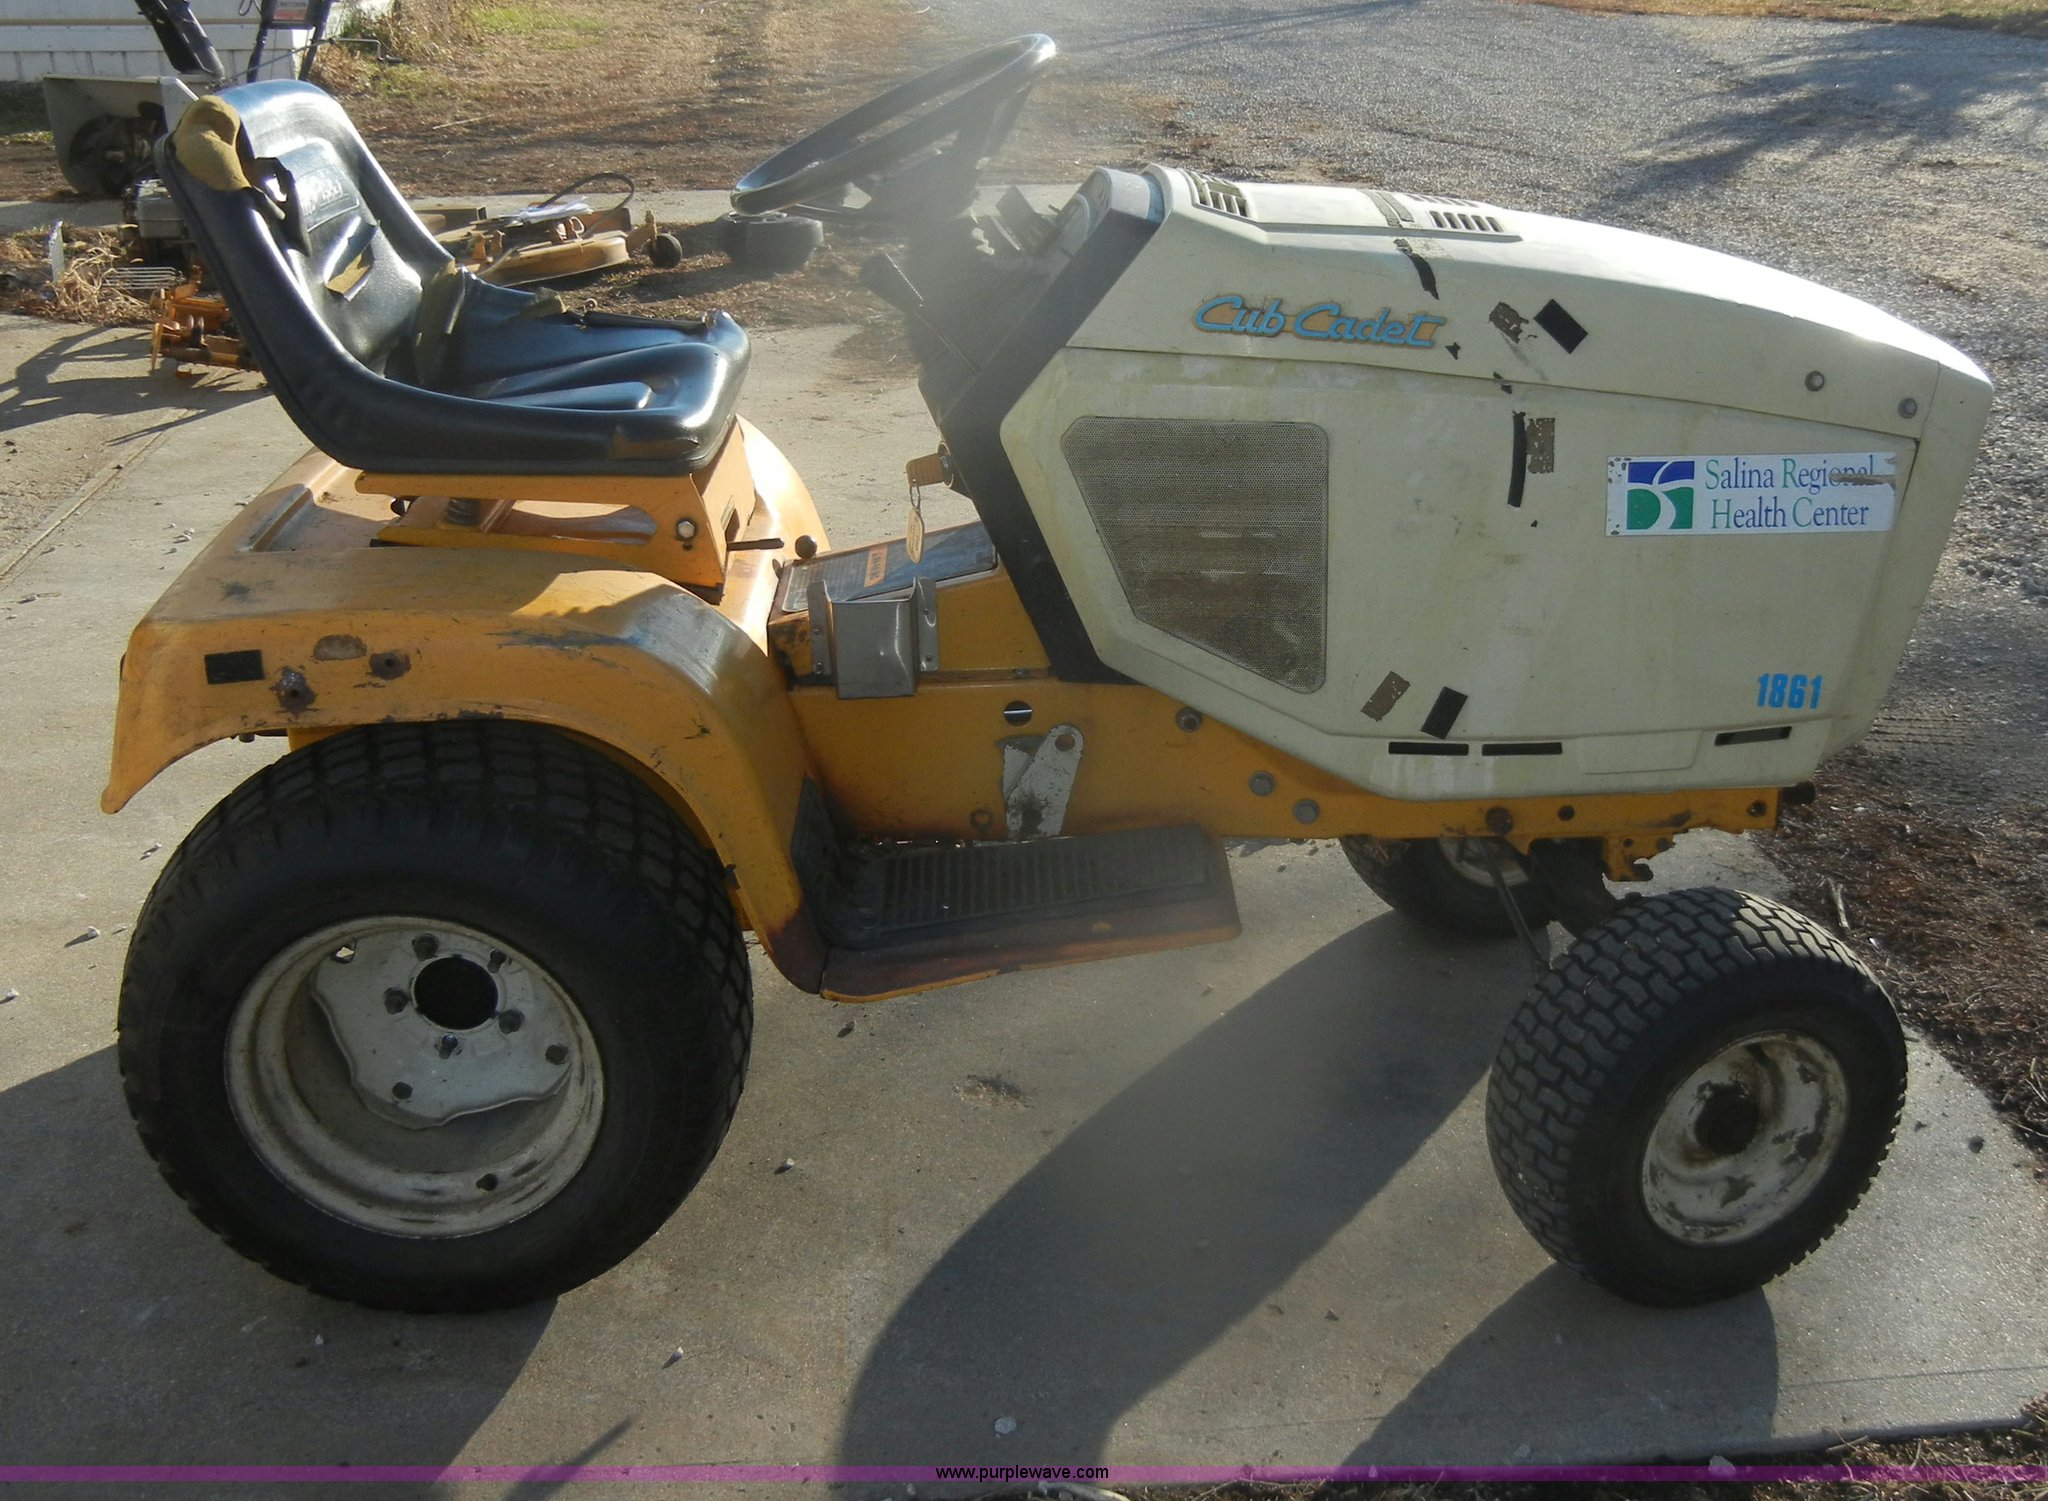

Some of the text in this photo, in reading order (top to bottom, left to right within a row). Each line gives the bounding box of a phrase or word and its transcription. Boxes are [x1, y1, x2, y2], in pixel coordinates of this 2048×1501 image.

[1194, 294, 1447, 348] Cub Cadet
[1705, 457, 1774, 490] Salina
[1711, 496, 1869, 529] Health Center
[1757, 673, 1823, 709] 1861
